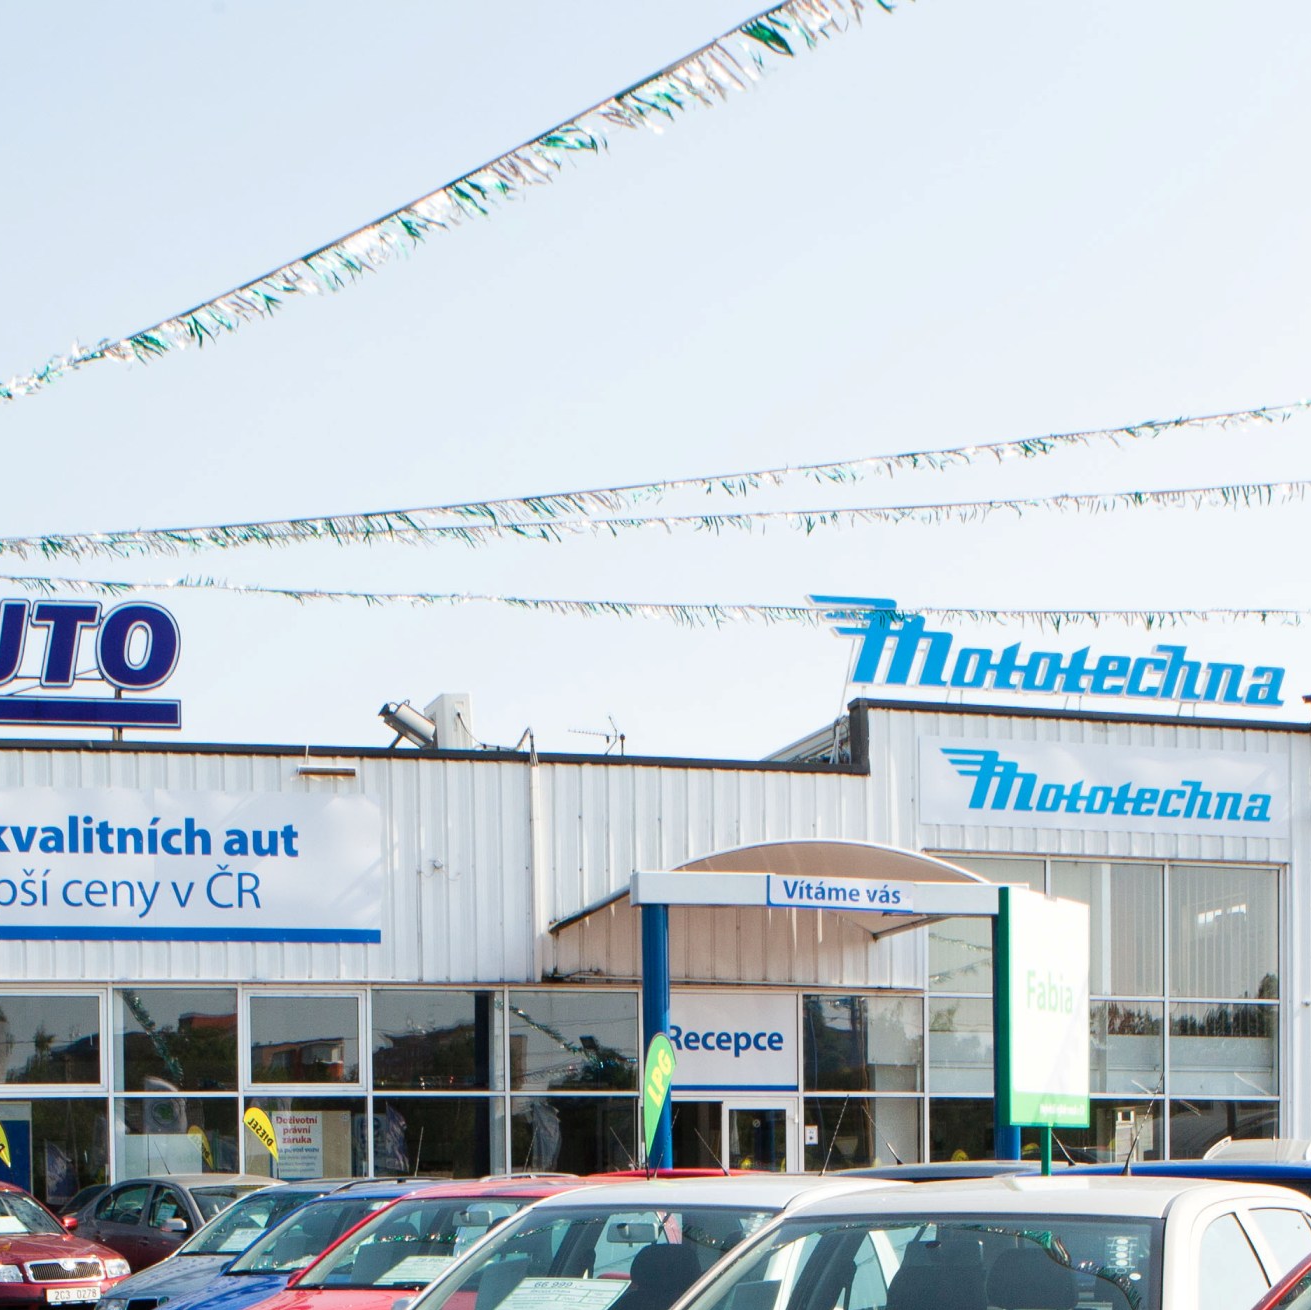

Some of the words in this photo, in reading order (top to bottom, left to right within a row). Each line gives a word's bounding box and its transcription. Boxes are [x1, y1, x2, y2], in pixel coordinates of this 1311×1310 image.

[805, 594, 1285, 708] Mototechna
[940, 748, 1272, 823] Mototechna
[222, 820, 299, 858] aut
[61, 876, 159, 920] ceny
[170, 880, 192, 909] v
[206, 864, 262, 910] ČR
[783, 877, 860, 905] Vítáme
[866, 880, 902, 907] vás
[1026, 970, 1073, 1014] Fabia
[670, 1025, 783, 1058] Recepce
[647, 1048, 672, 1108] LPG
